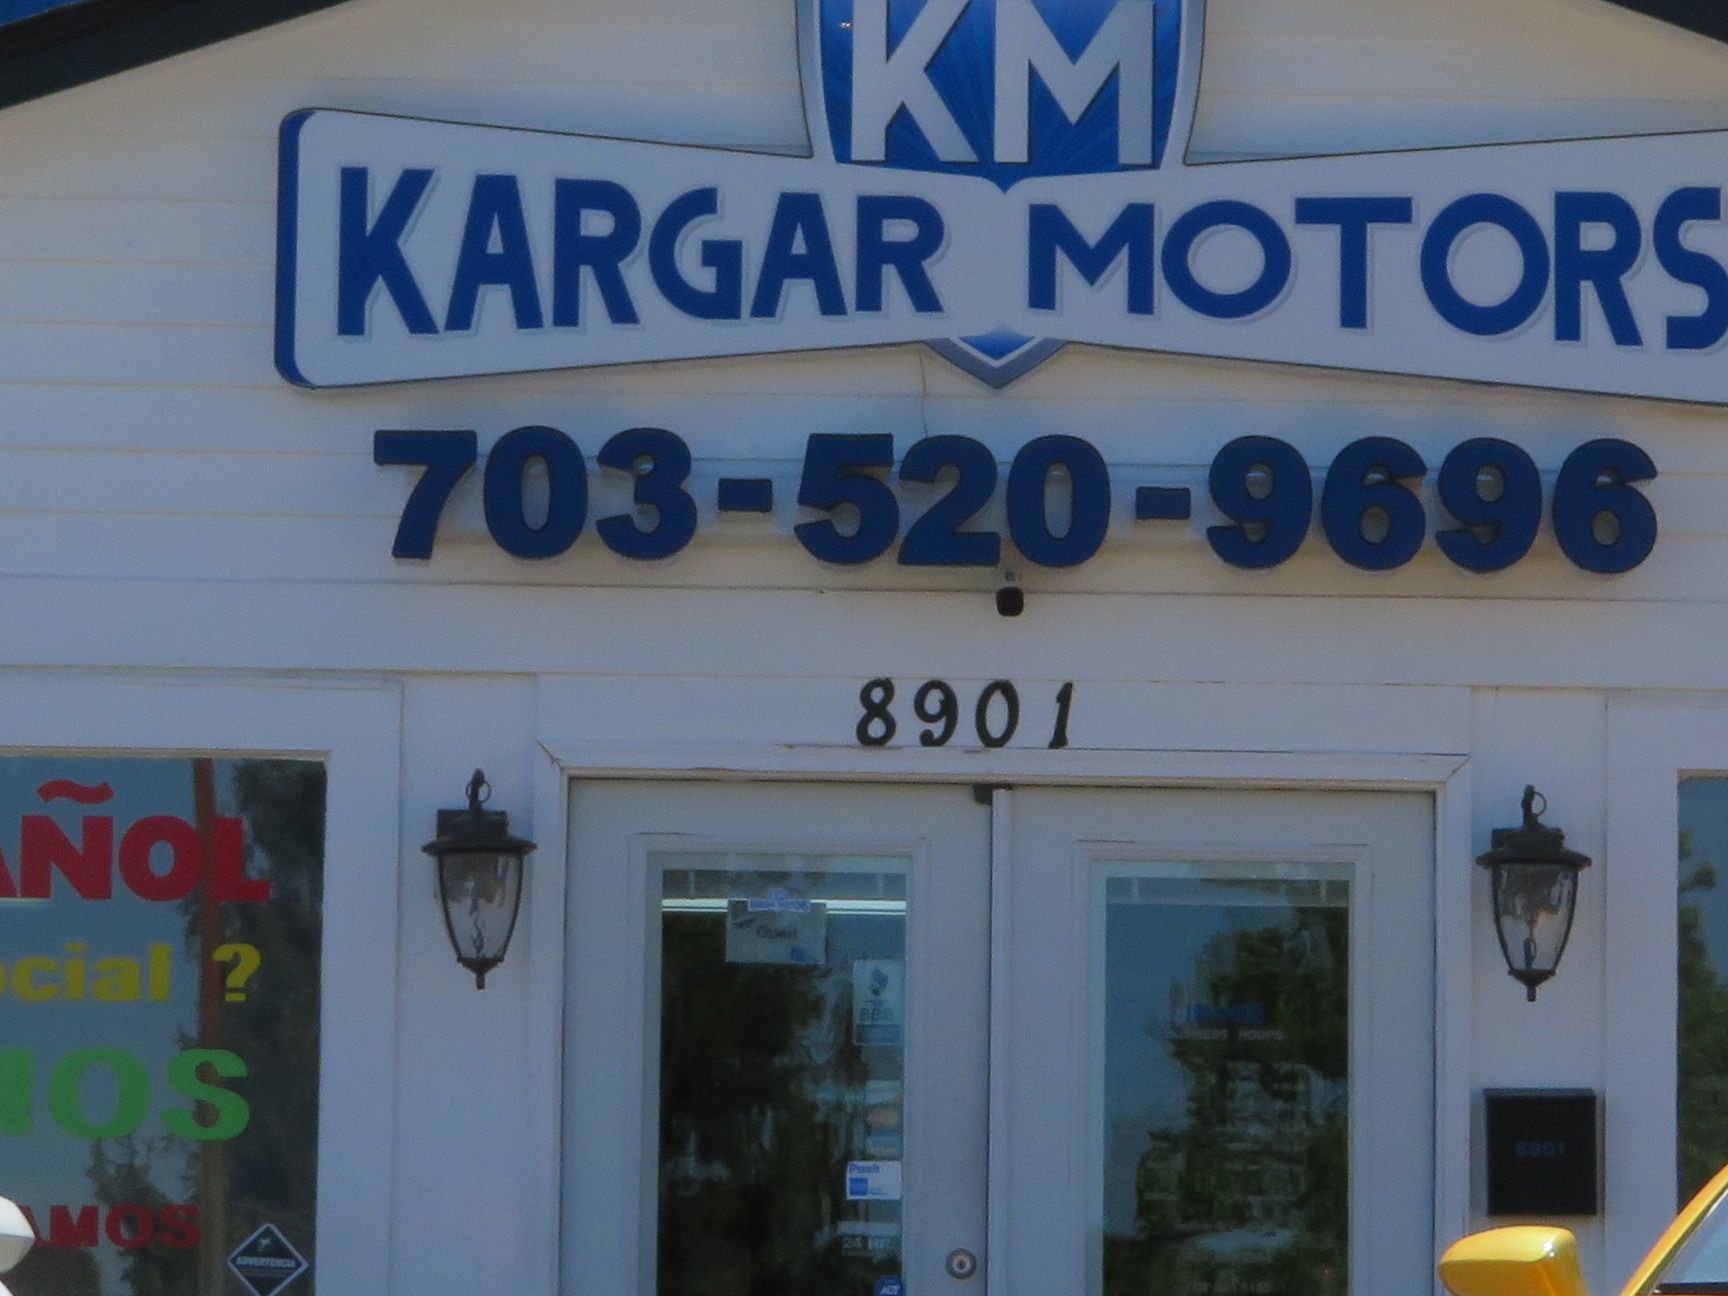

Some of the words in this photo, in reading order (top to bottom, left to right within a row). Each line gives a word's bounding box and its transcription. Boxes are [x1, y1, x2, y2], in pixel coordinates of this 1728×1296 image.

[337, 165, 948, 337] KARGAR
[372, 424, 1660, 574] 703-520-9696
[854, 676, 1078, 750] 8901
